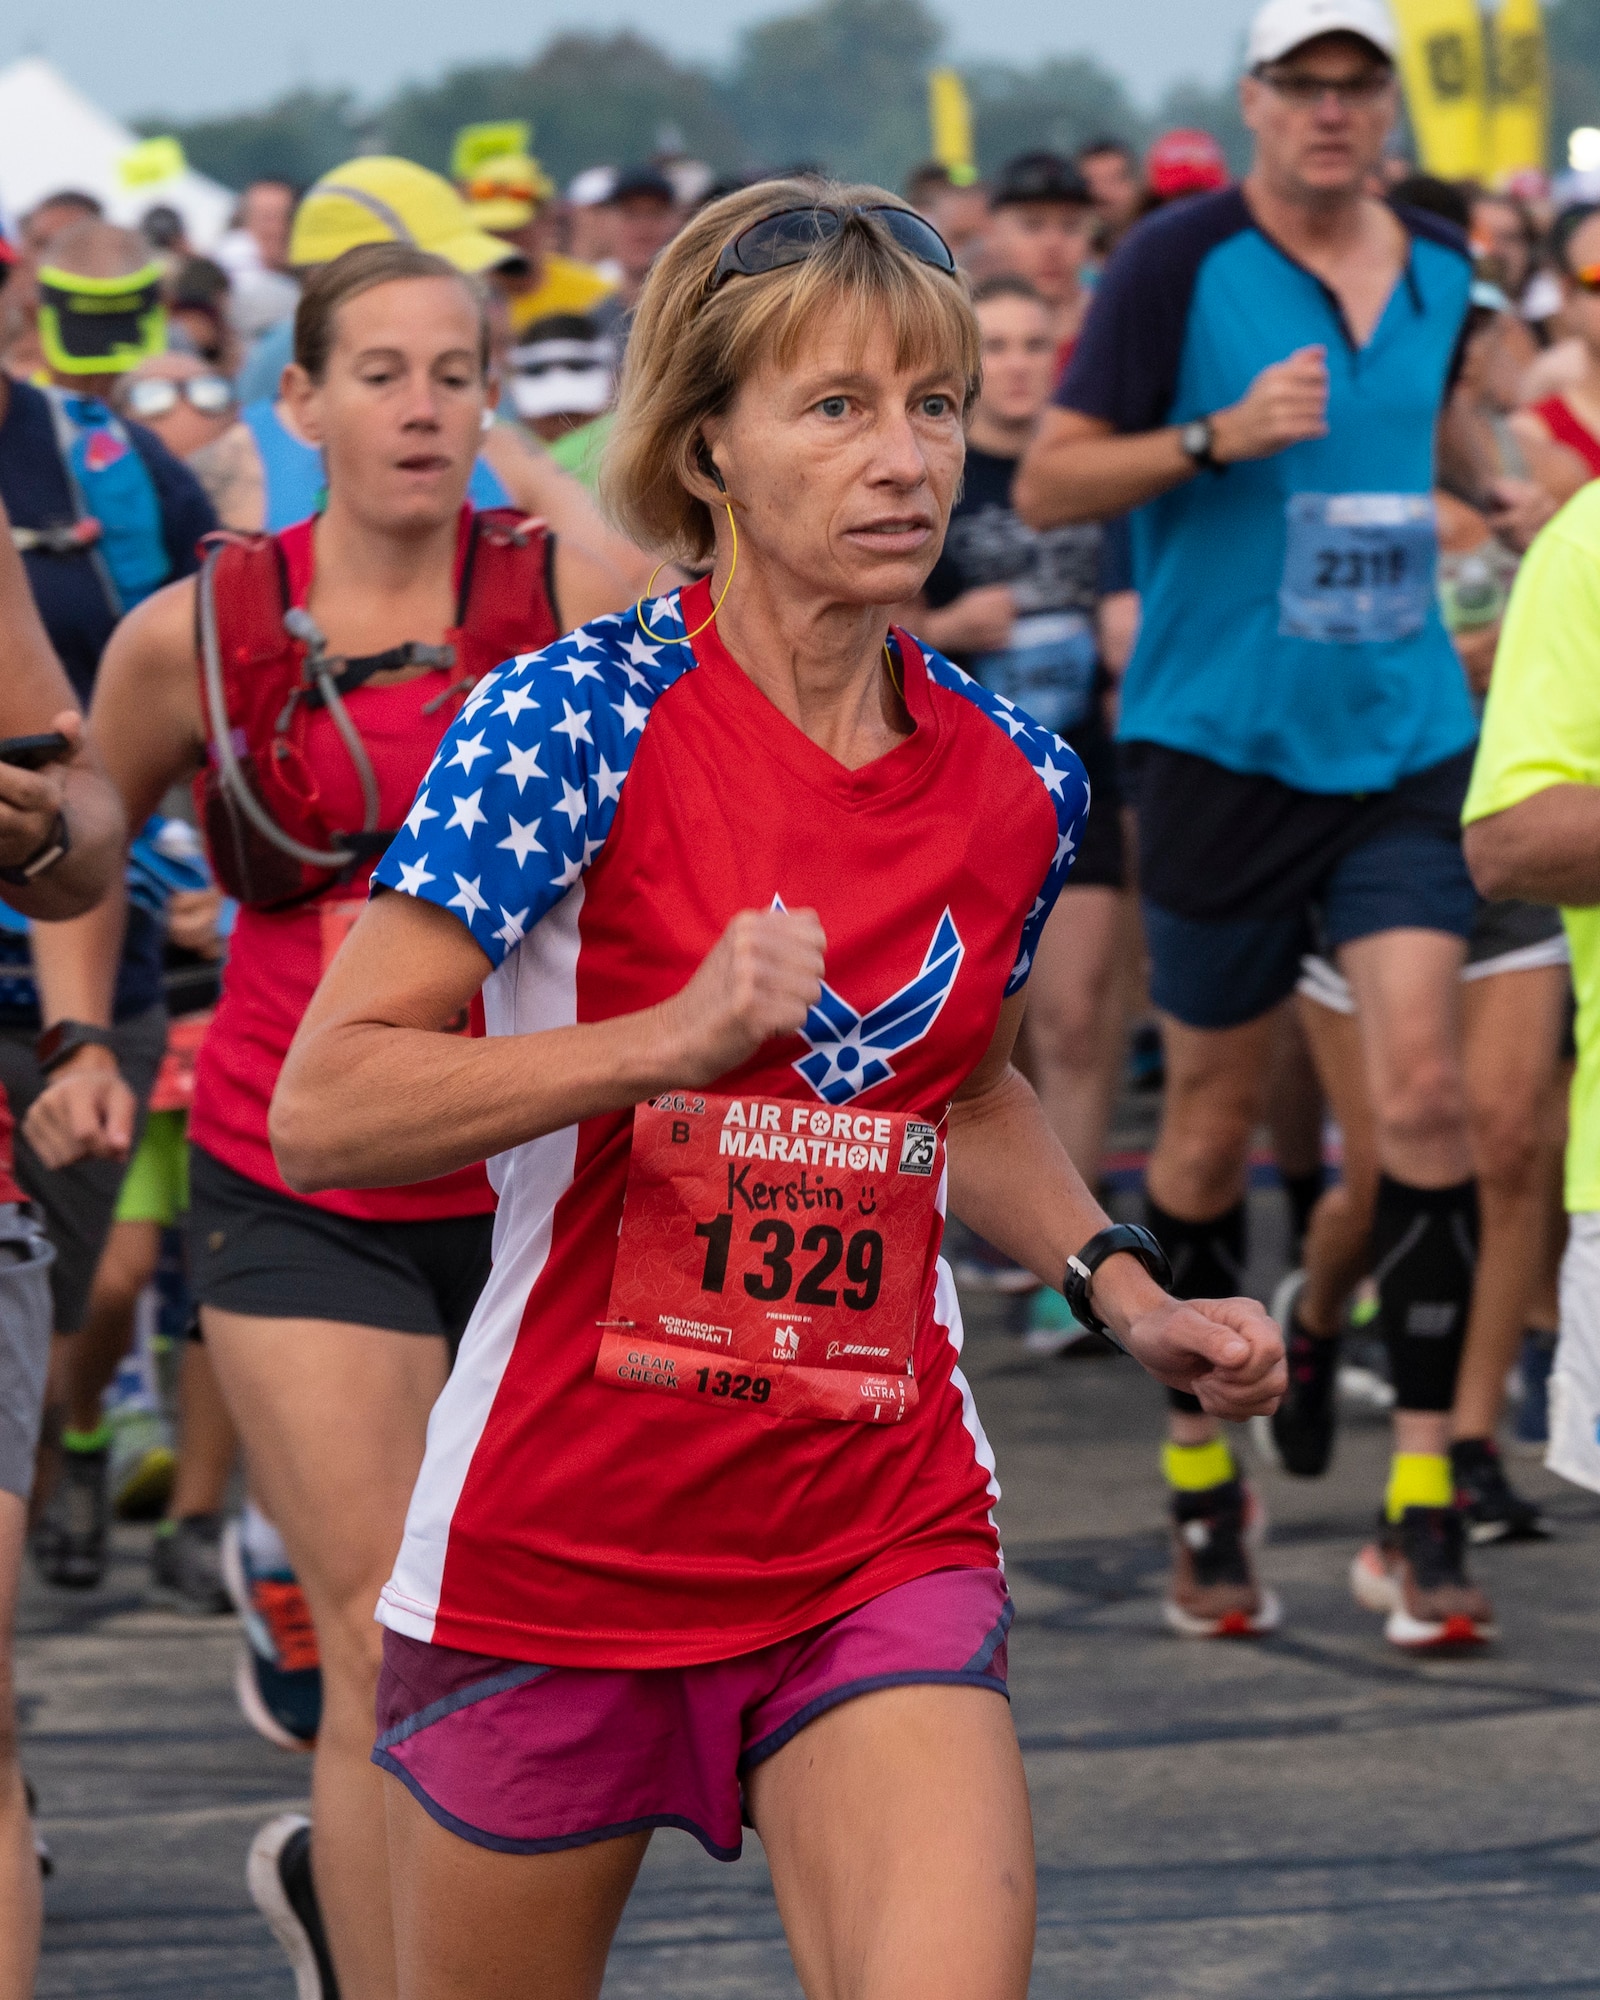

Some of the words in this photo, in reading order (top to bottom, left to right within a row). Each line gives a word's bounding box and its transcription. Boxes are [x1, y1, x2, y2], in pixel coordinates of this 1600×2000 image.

[659, 1094, 706, 1115] 26.2
[671, 1120, 690, 1144] B
[723, 1101, 782, 1132] AIR
[791, 1108, 891, 1144] FORCE
[719, 1130, 889, 1173] MARATHON
[905, 1133, 934, 1165] 75
[727, 1162, 844, 1213] Kerstin
[694, 1212, 884, 1311] 1329
[658, 1314, 715, 1333] NORTHROP
[766, 1311, 802, 1322] PRESENTED
[665, 1325, 721, 1344] GRUMMAN
[627, 1352, 676, 1373] GEAR
[843, 1344, 890, 1357] BOEING
[617, 1365, 678, 1389] CHECK
[696, 1367, 771, 1404] 1329
[860, 1385, 896, 1399] ULTRA
[896, 1380, 905, 1421] DRINK
